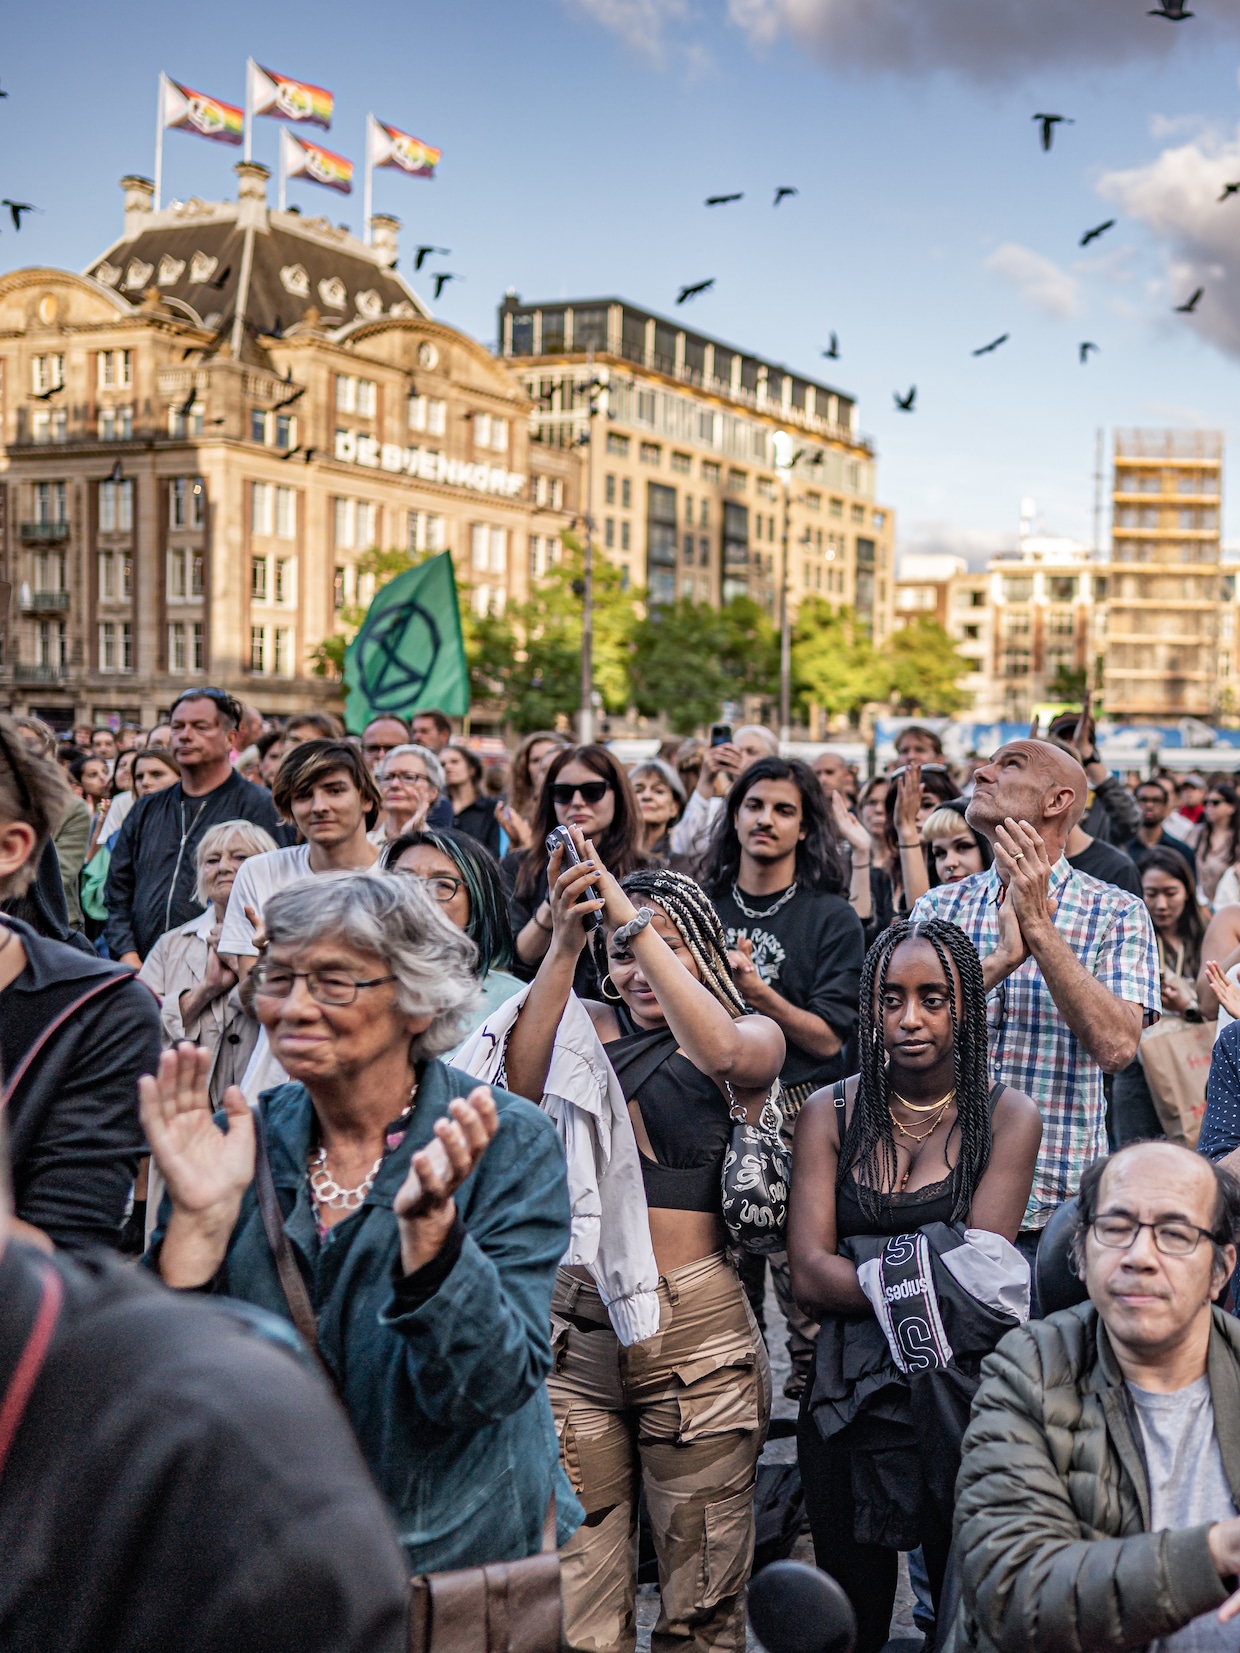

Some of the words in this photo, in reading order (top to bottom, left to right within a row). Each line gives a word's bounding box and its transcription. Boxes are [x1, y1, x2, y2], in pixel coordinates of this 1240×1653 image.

[335, 432, 380, 468] DE
[751, 928, 786, 963] RACISM
[886, 1277, 928, 1303] snipes
